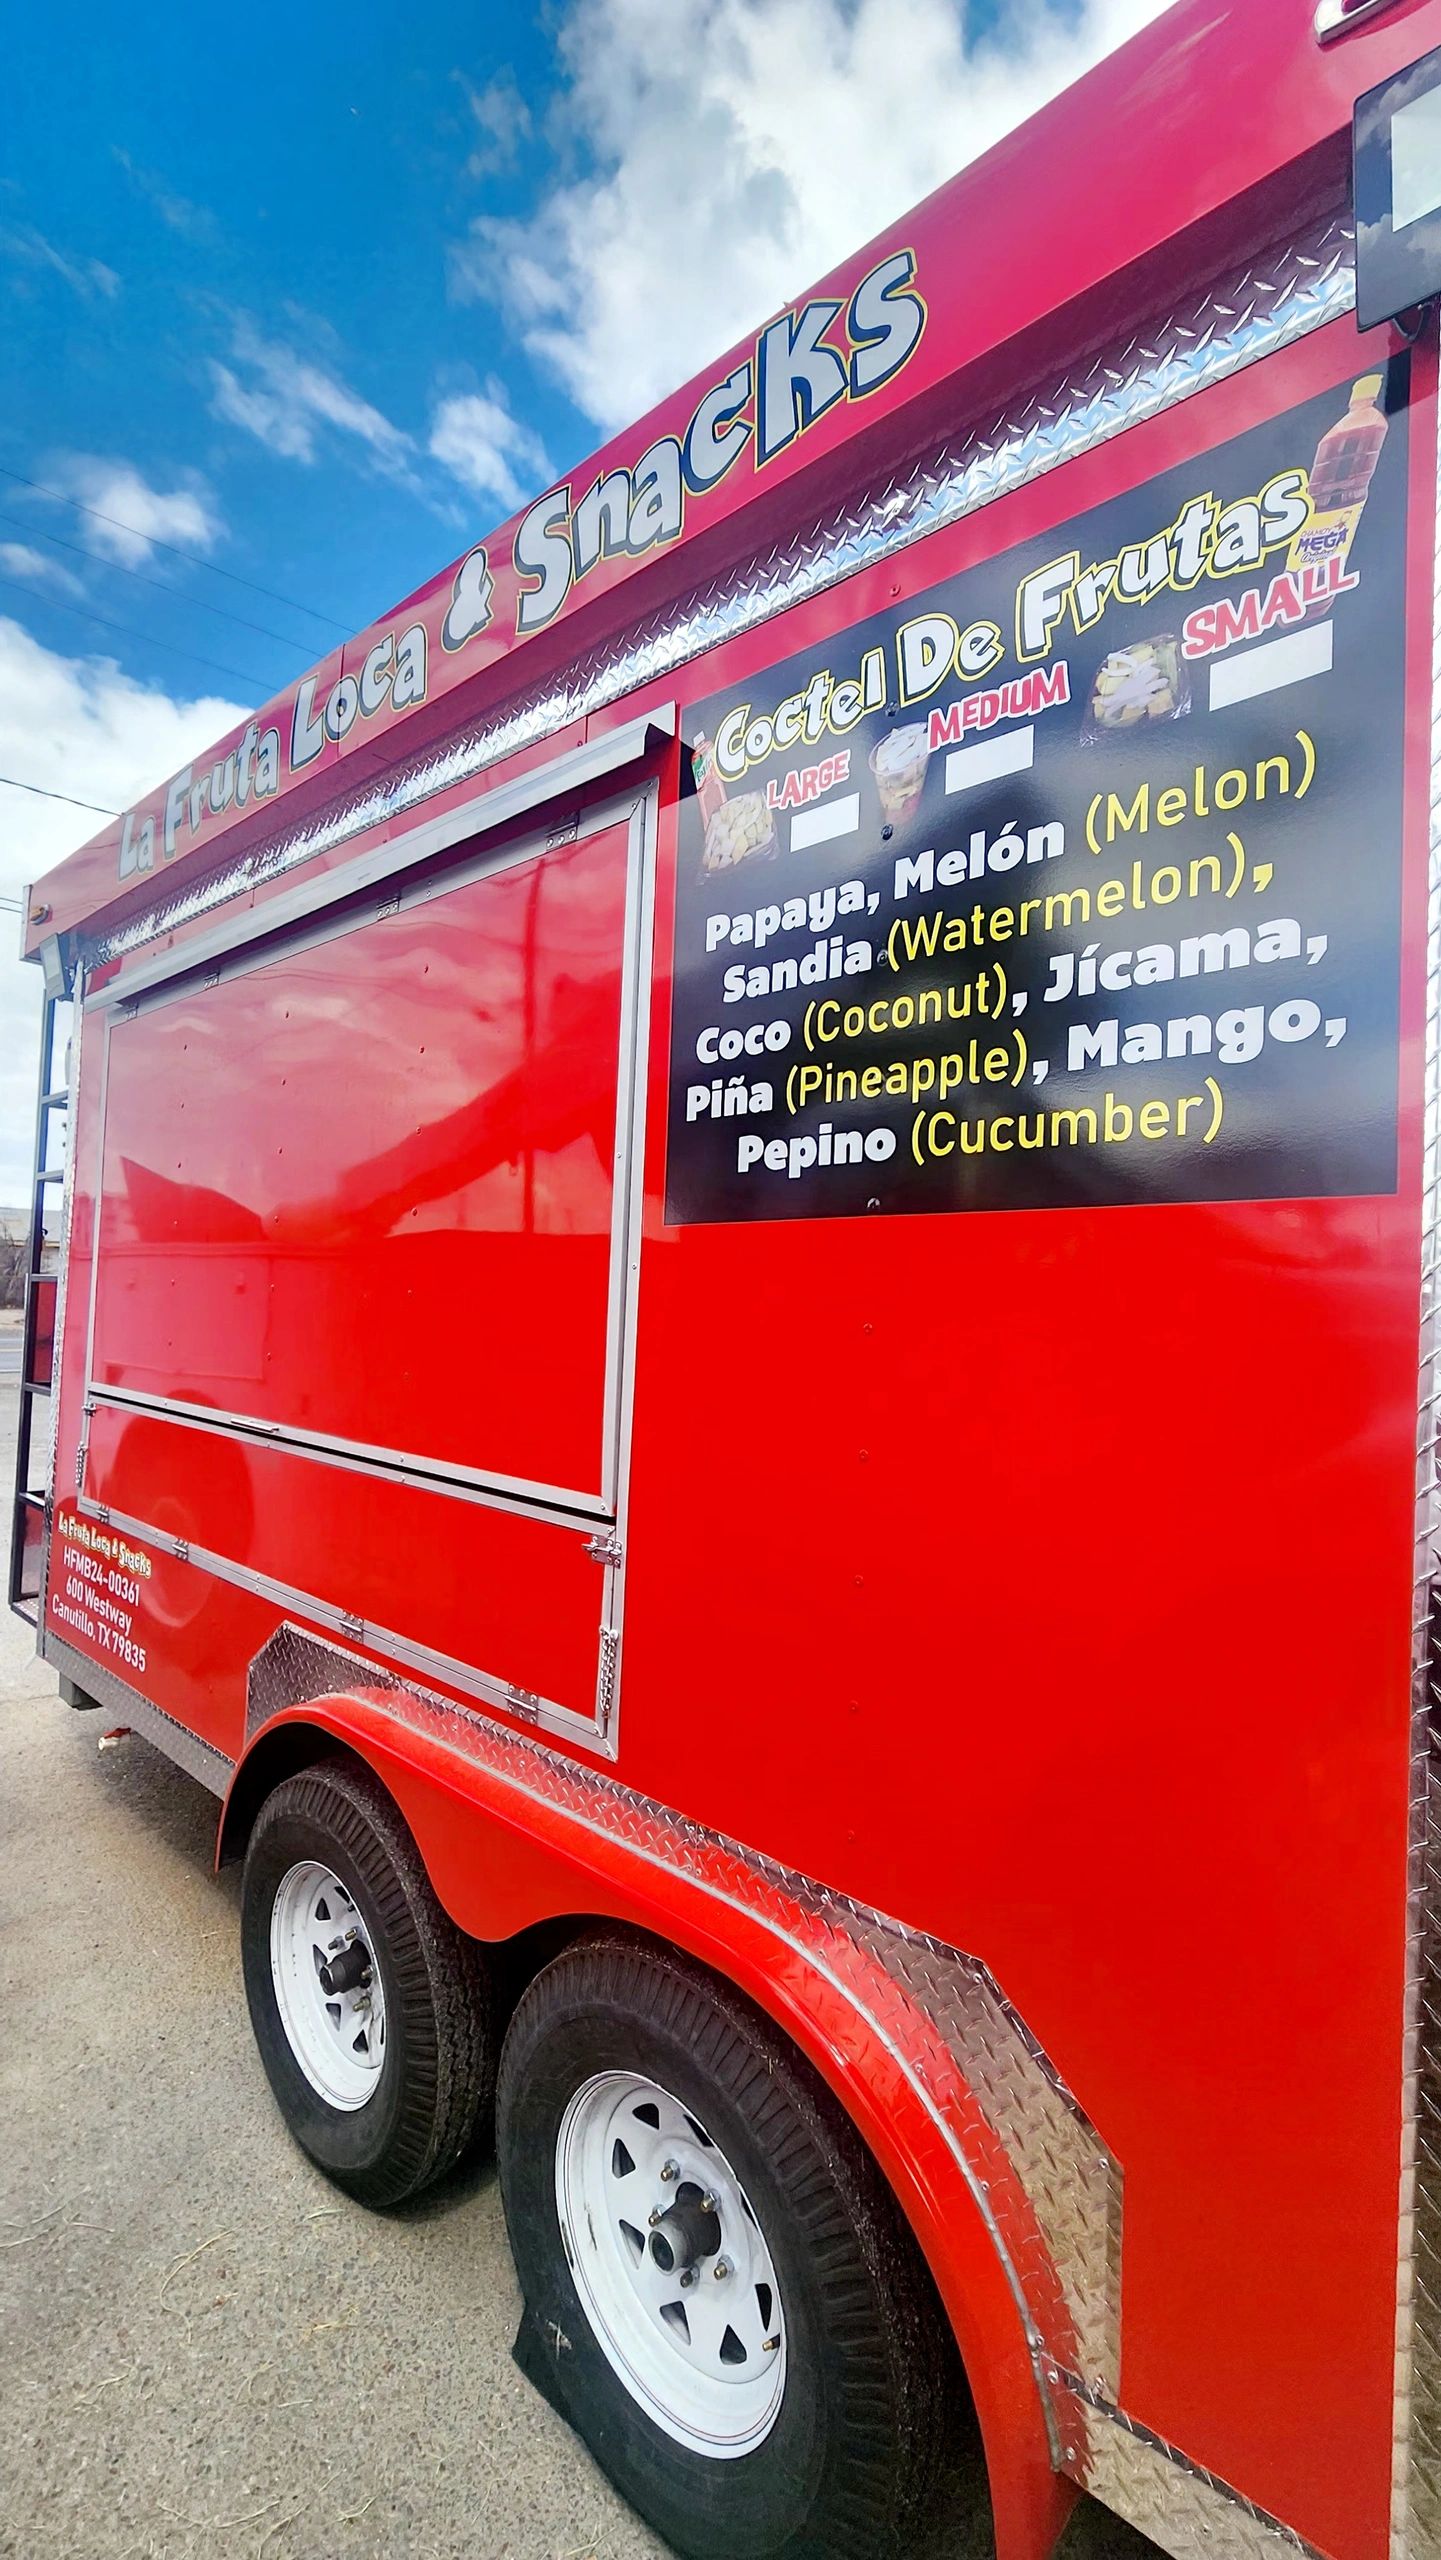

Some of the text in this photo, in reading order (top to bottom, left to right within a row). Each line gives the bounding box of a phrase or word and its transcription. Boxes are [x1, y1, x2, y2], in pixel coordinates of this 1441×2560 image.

[1295, 526, 1349, 556] MEGA
[714, 468, 1315, 782] Coctel De Frutas
[1181, 556, 1360, 660] SMALL
[118, 811, 154, 881] La
[163, 721, 280, 861] Fruta
[289, 623, 428, 775] Loca
[441, 547, 495, 652] &
[926, 660, 1071, 752] MEDIUM
[766, 749, 851, 809] LARGE
[705, 730, 1317, 953] Papaya, Melón (Melon)
[723, 832, 1273, 1003] Sandia (Watermelon),
[696, 917, 1329, 1064] Coco (Coconut), Jícama,
[685, 997, 1348, 1121] Piña (Pineapple), Mango,
[737, 1077, 1224, 1178] Pepino (Cucumber)
[58, 1511, 68, 1537] La
[68, 1516, 91, 1550] Fruta
[91, 1527, 111, 1560] Loca
[112, 1538, 118, 1558] &
[63, 1545, 140, 1607] HFMB24-00361
[52, 1594, 147, 1673] Canutillo, TX 79835
[65, 1575, 132, 1635] 600 Westway
